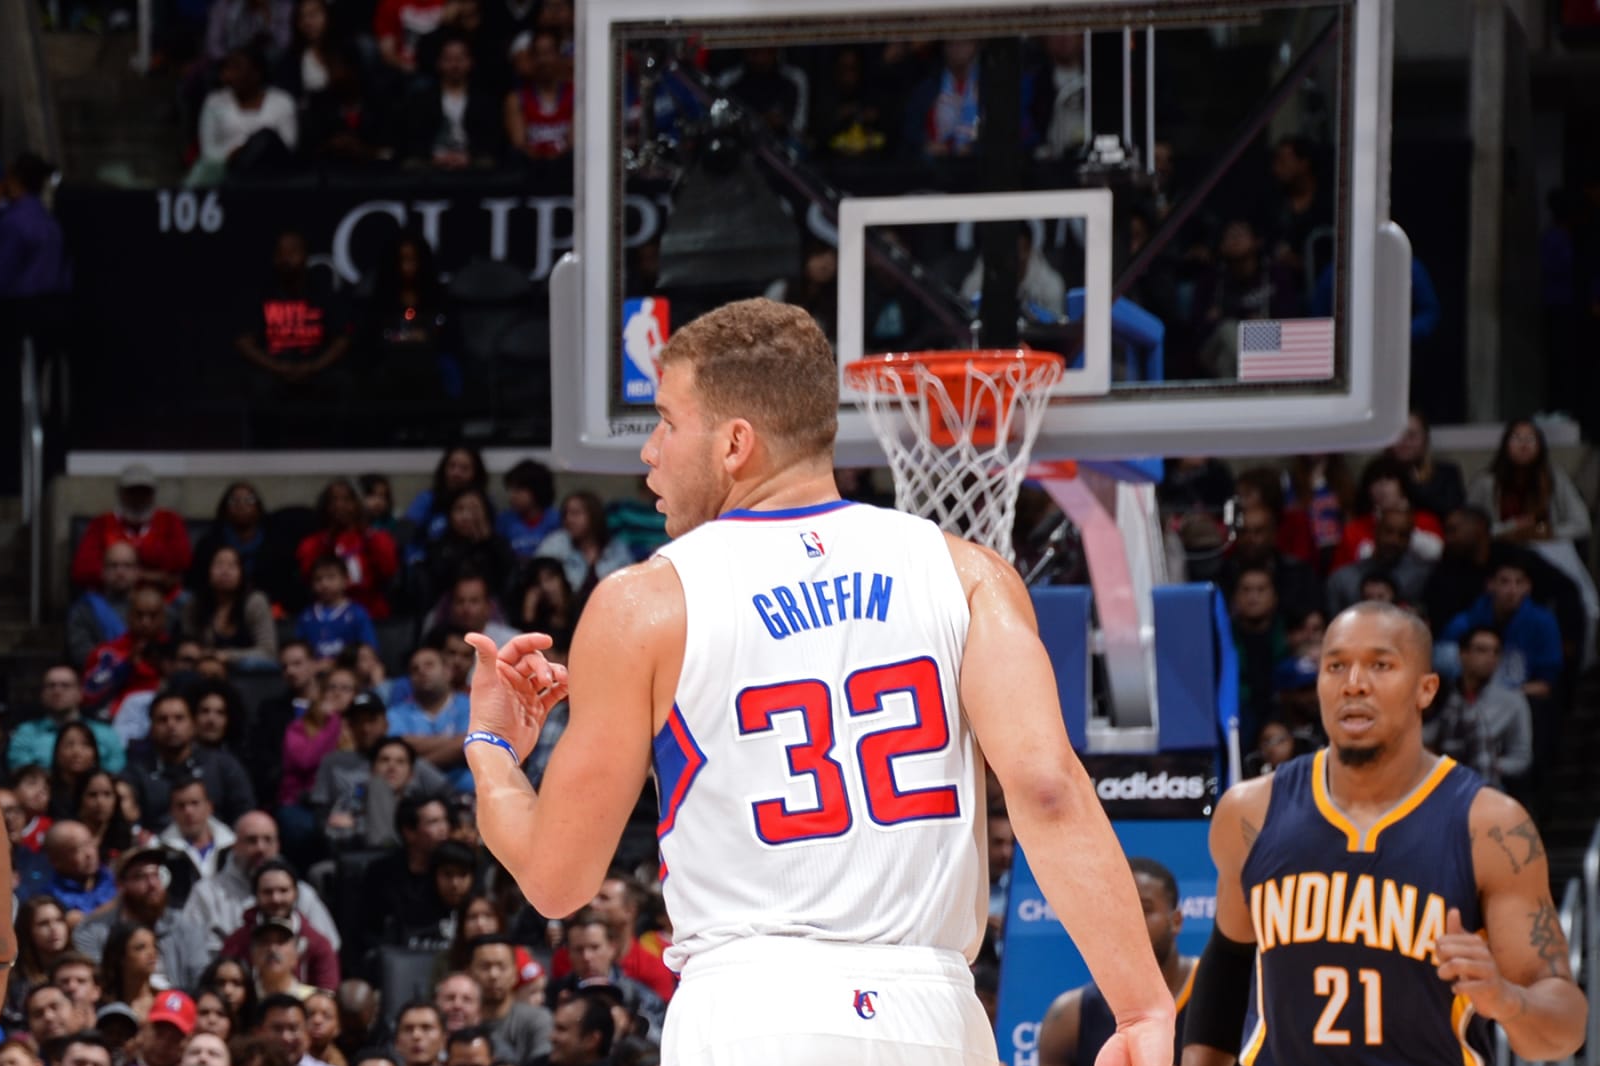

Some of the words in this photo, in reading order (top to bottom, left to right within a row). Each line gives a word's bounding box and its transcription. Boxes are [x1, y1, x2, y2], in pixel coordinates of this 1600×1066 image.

[158, 191, 224, 233] 106
[752, 572, 893, 640] GRIFFIN
[735, 655, 961, 846] 32
[1097, 771, 1204, 799] adidas
[1250, 871, 1445, 967] INDIANA
[1312, 965, 1384, 1046] 21
